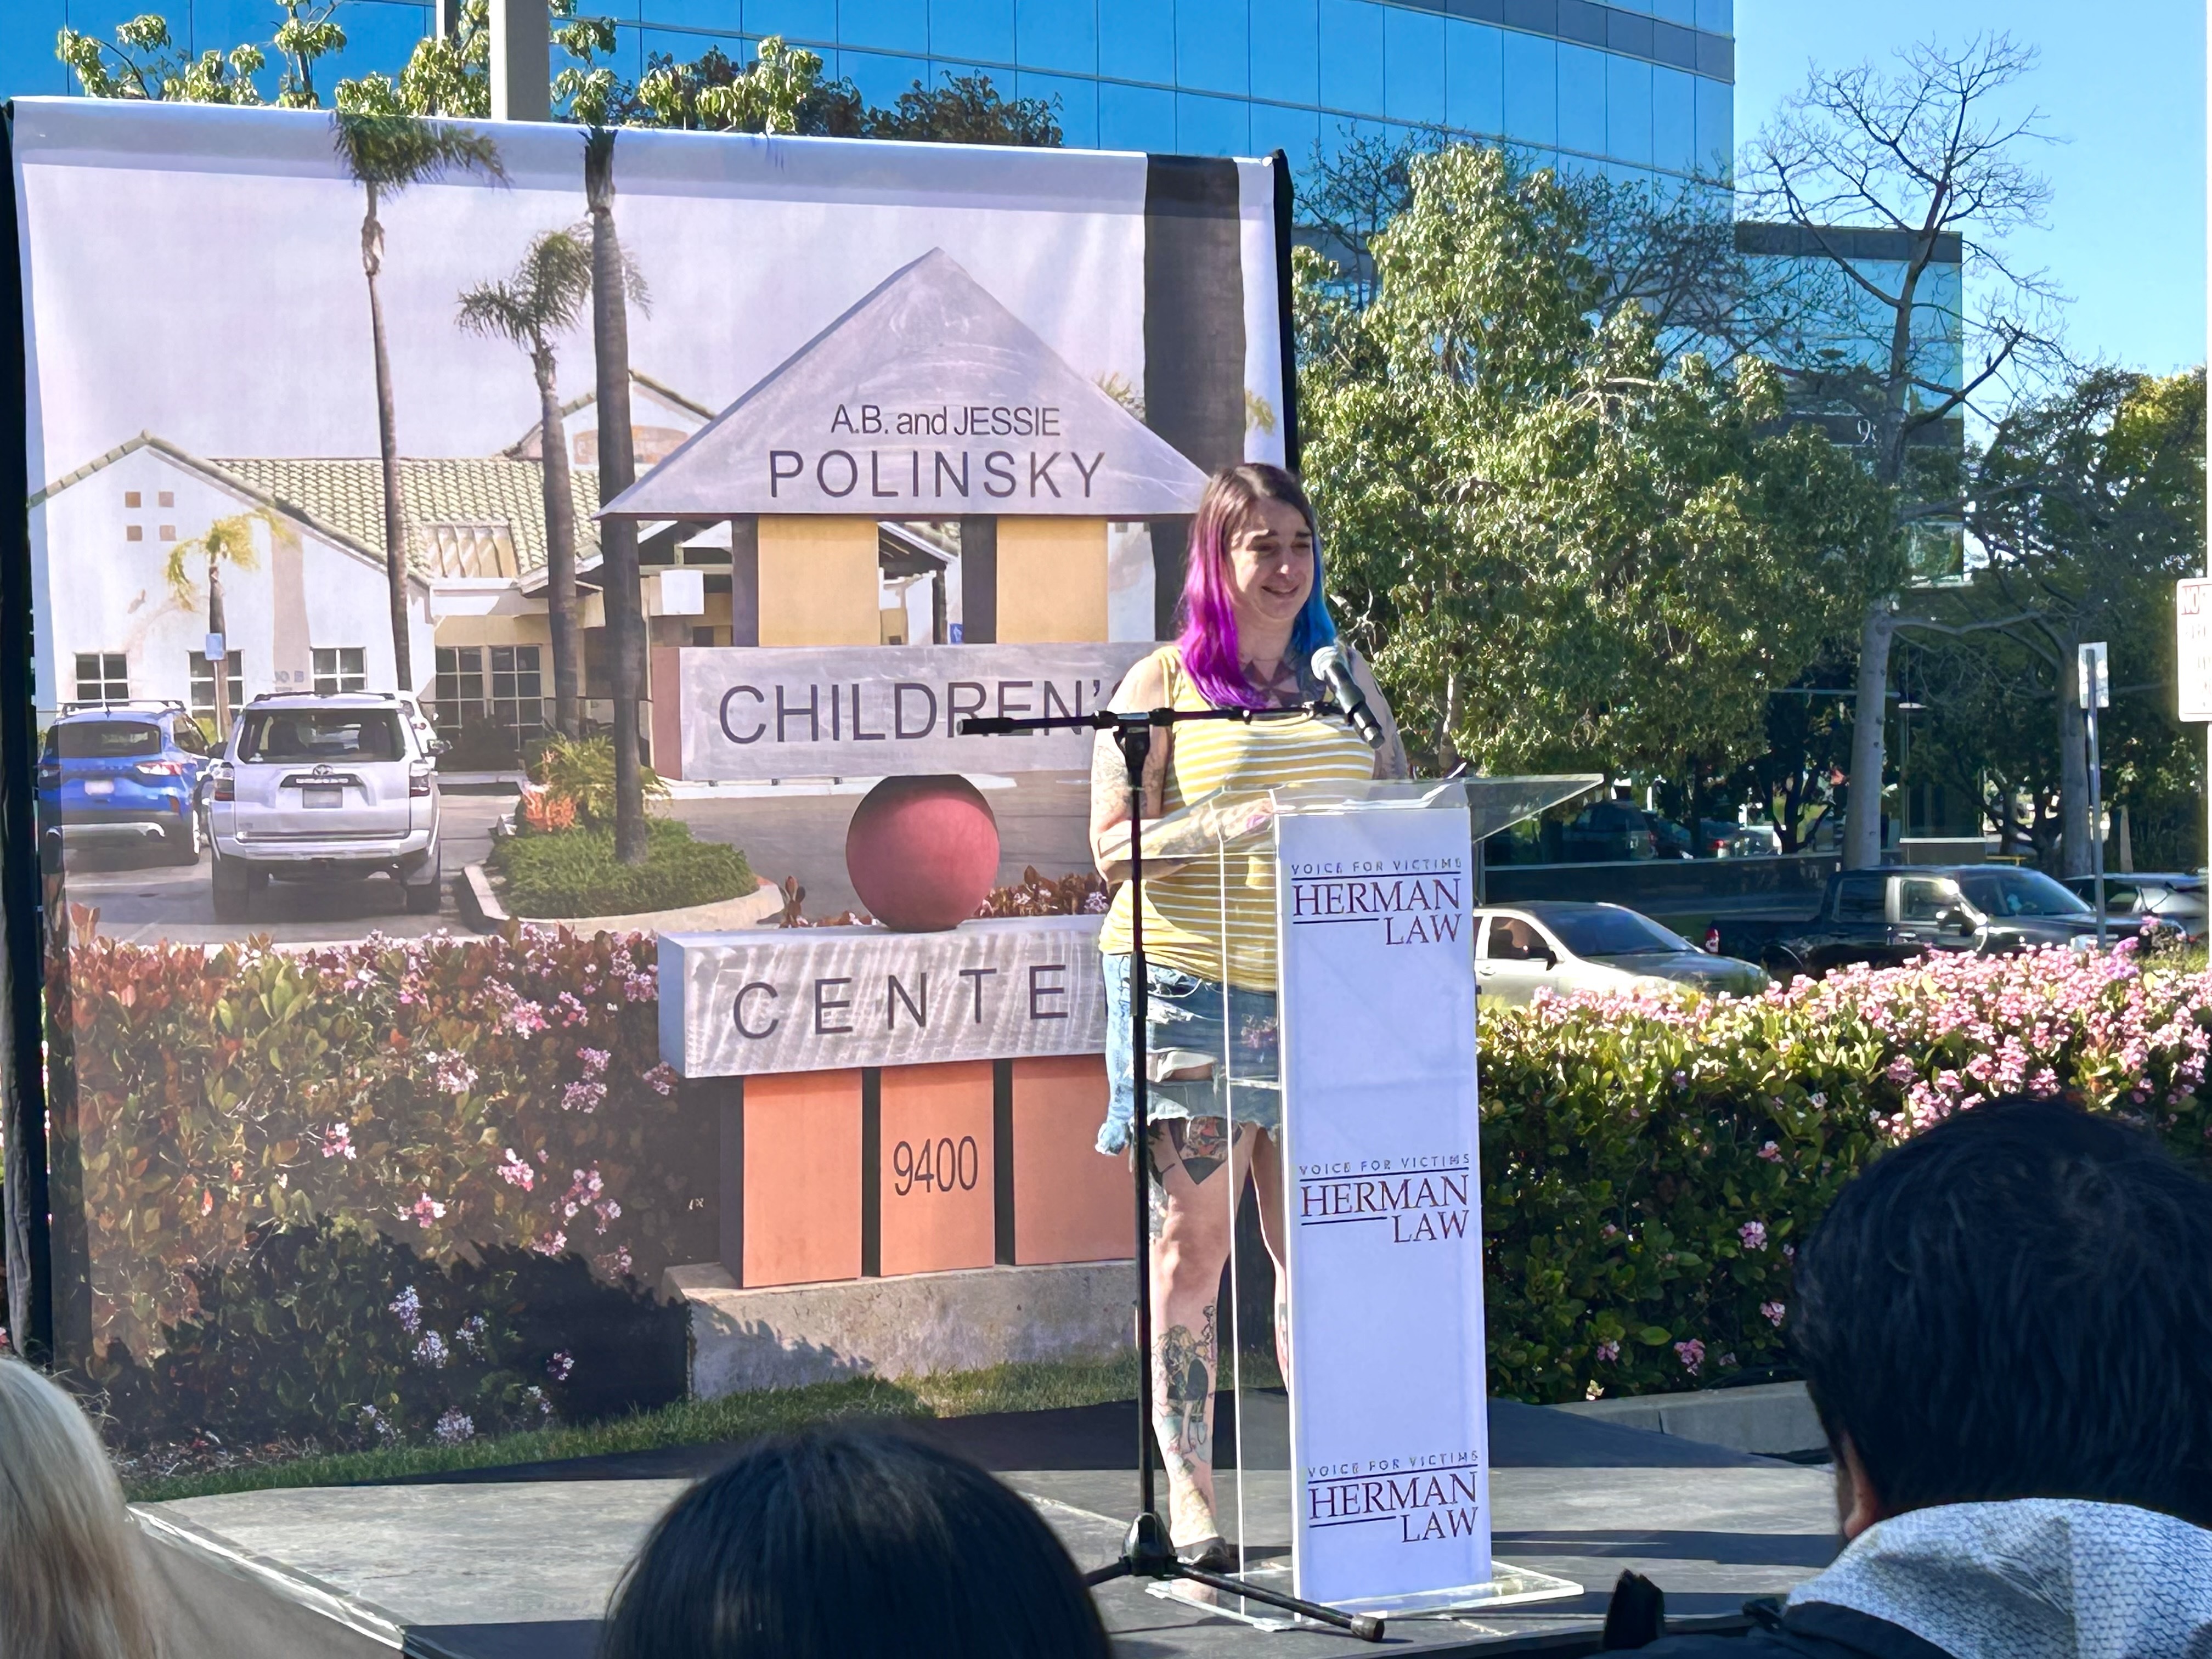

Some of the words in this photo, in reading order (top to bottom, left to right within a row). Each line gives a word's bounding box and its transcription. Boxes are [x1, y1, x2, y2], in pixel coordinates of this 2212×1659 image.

[830, 403, 889, 435] A.B.
[896, 406, 947, 436] and
[953, 407, 1060, 436] JESSIE
[769, 449, 1105, 498] POLINSKY
[719, 679, 1123, 744] CHILDREN'
[1291, 862, 1342, 875] VOICE
[1353, 860, 1383, 872] FOR
[1392, 857, 1462, 871] VICTIMS
[1292, 878, 1462, 916] HERMAN
[1383, 913, 1462, 945] LAW
[732, 964, 1109, 1040] CENTE
[893, 1135, 979, 1197] 9400
[1299, 1161, 1351, 1176] VOICE
[1361, 1159, 1391, 1171] FOR
[1401, 1153, 1470, 1168] VICTIMS
[1300, 1174, 1469, 1217] HERMAN
[1391, 1209, 1470, 1243] LAW
[1308, 1462, 1359, 1477] VOICE
[1369, 1458, 1400, 1471] FOR
[1409, 1450, 1479, 1468] VICTIMS
[1308, 1471, 1478, 1520] HERMAN
[1400, 1506, 1479, 1543] LAW
